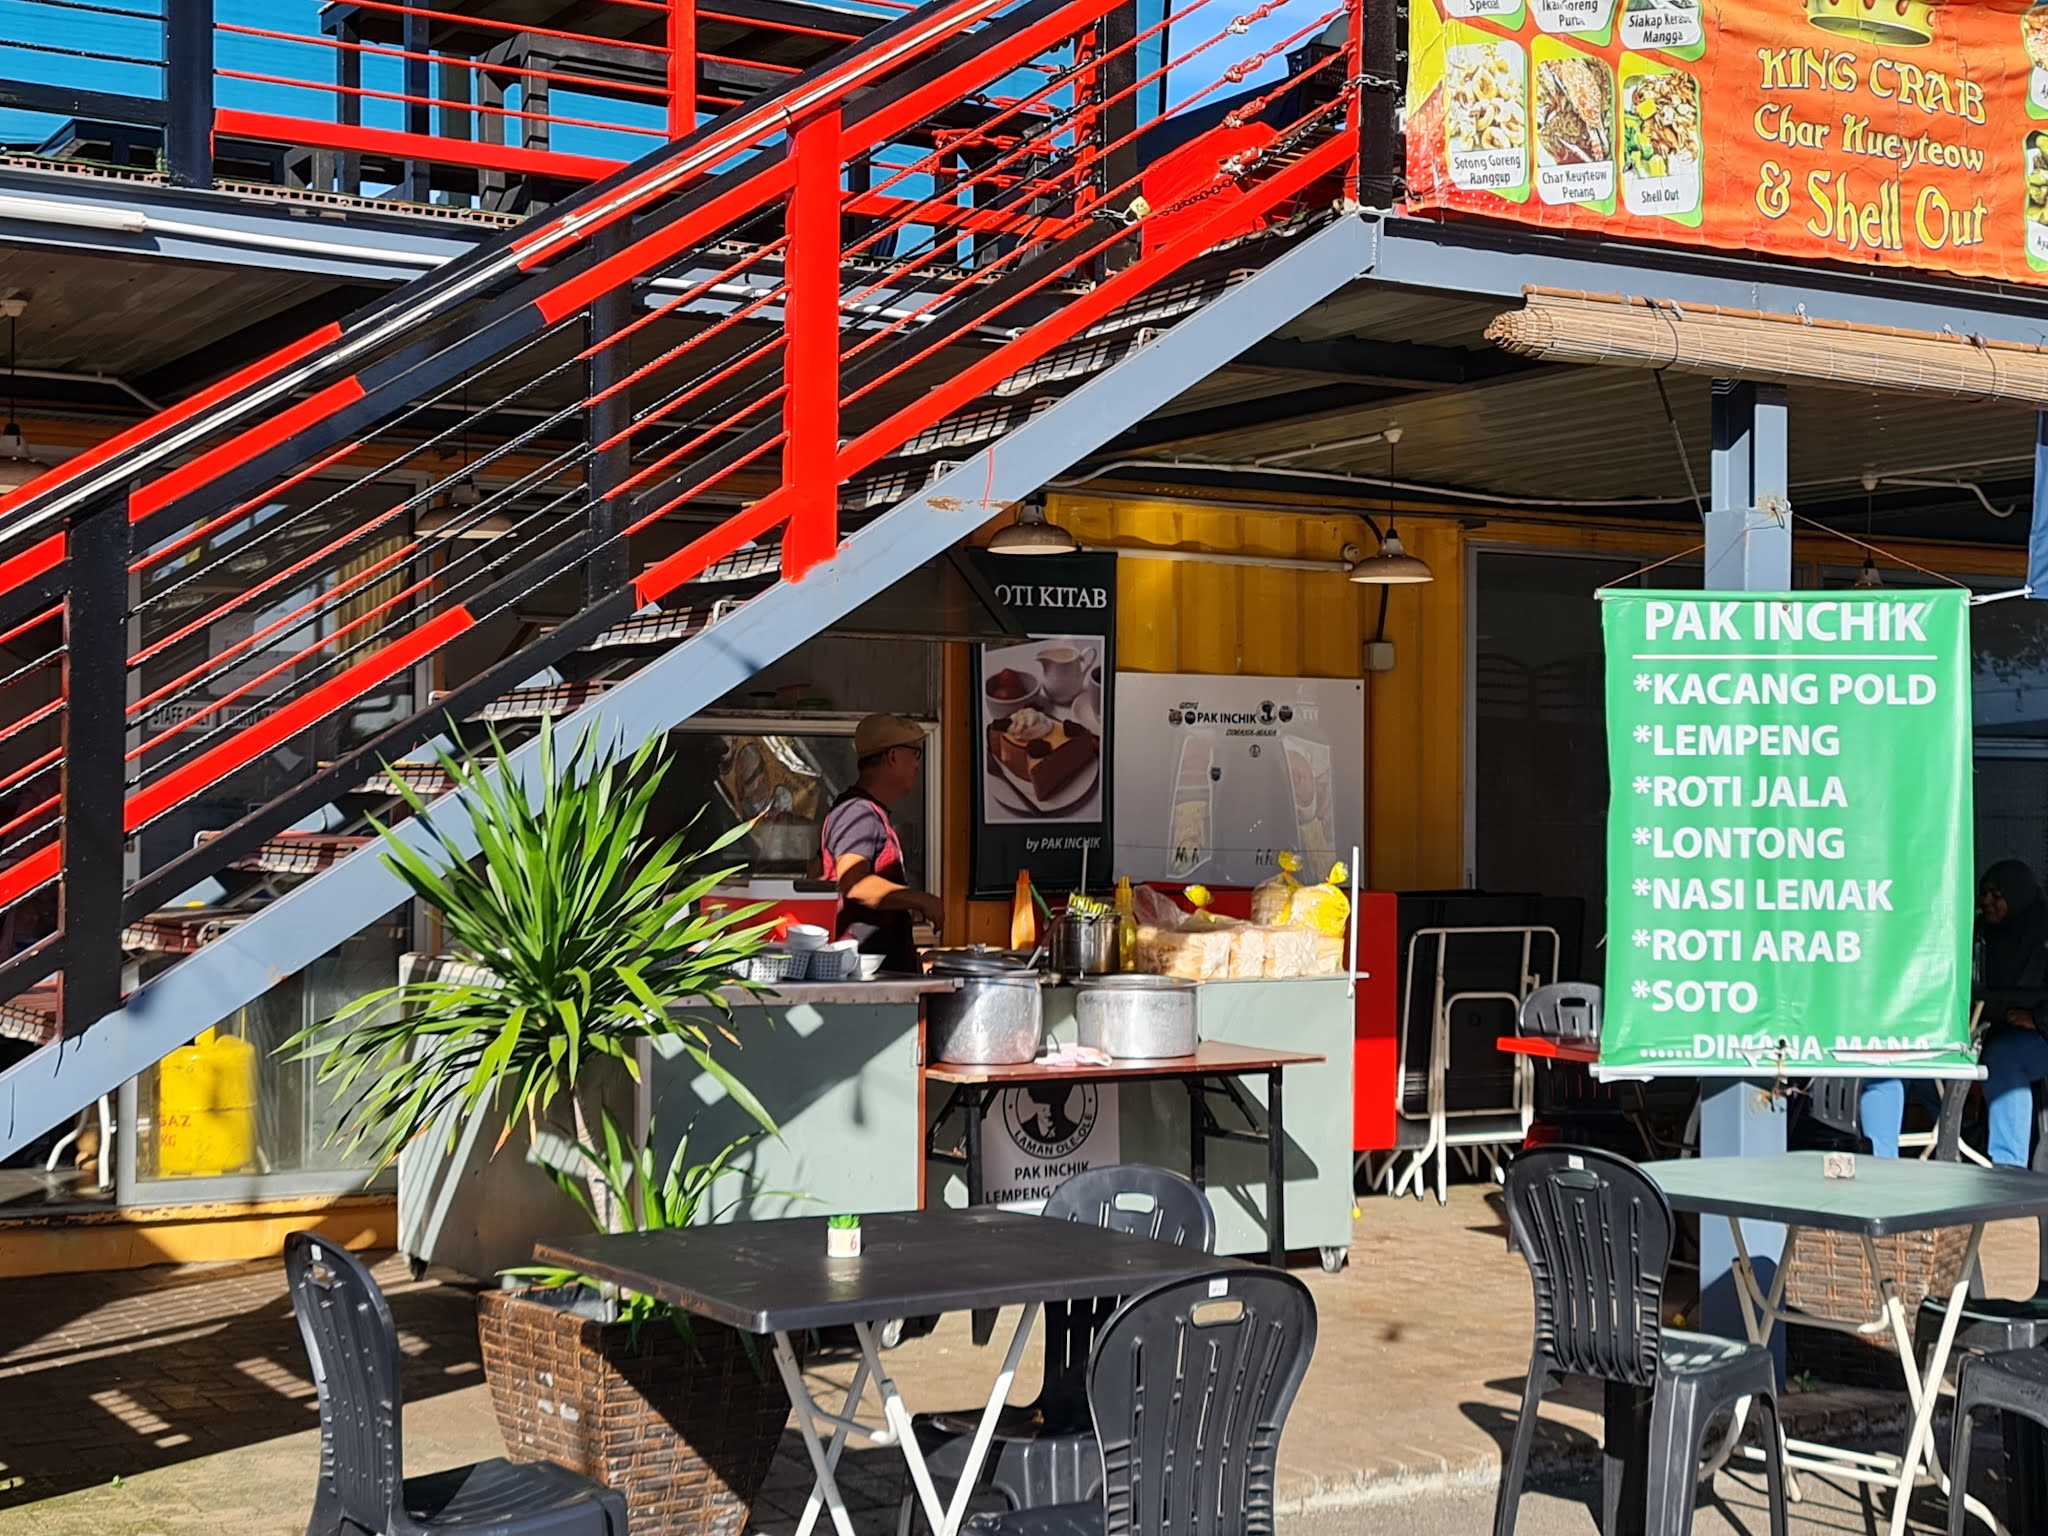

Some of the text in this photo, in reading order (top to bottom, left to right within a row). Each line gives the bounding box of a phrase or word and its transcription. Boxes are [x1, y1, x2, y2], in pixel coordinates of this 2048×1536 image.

[1628, 13, 1663, 29] Siakap
[1643, 30, 1684, 45] Mangga
[1757, 47, 1987, 125] KING CRAB
[1753, 102, 1985, 173] Char Kueyteow
[1454, 154, 1521, 170] Sotong Goreng
[1542, 171, 1564, 185] Char
[1562, 186, 1596, 200] Penang
[1641, 189, 1680, 203] Shell Out
[1755, 160, 1988, 250] & Shell Out
[994, 584, 1107, 608] OTI KITAB
[1645, 601, 1927, 642] PAK INCHIK
[1830, 673, 1937, 706] POLD
[1197, 712, 1257, 725] PAK INCHIK
[1752, 776, 1848, 808] JALA
[1025, 836, 1102, 853] by PAK INCHIK
[1756, 879, 1894, 911] LEMAK
[1752, 930, 1861, 962] ARAB
[1015, 1113, 1093, 1155] LAMAN OLE-OLE
[1014, 1161, 1089, 1180] PAK INCHIK
[985, 1185, 1051, 1204] LEMPENG
